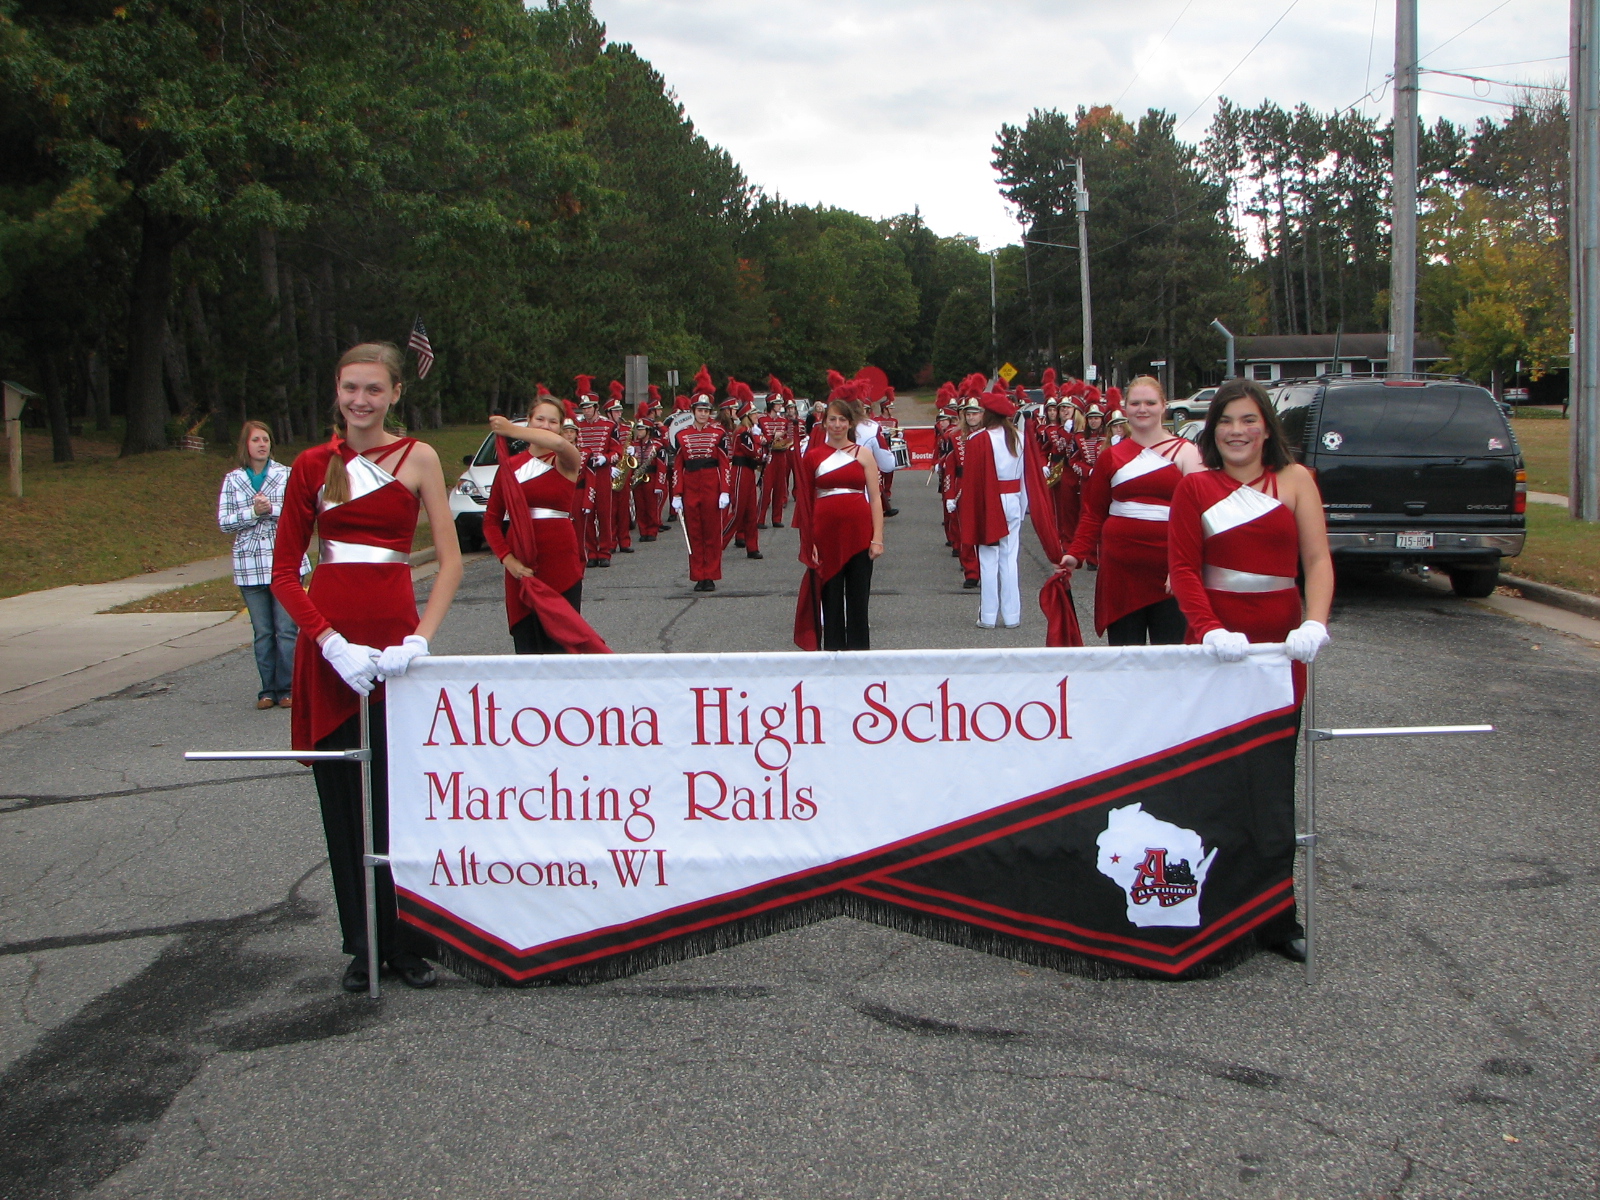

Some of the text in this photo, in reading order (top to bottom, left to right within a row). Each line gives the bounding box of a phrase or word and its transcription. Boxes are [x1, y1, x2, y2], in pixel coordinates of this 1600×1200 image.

[423, 675, 1073, 771] Altoona High School
[423, 766, 819, 842] Marching Rails
[429, 845, 669, 890] Altoona, WI
[1138, 887, 1193, 897] ALTOONA
